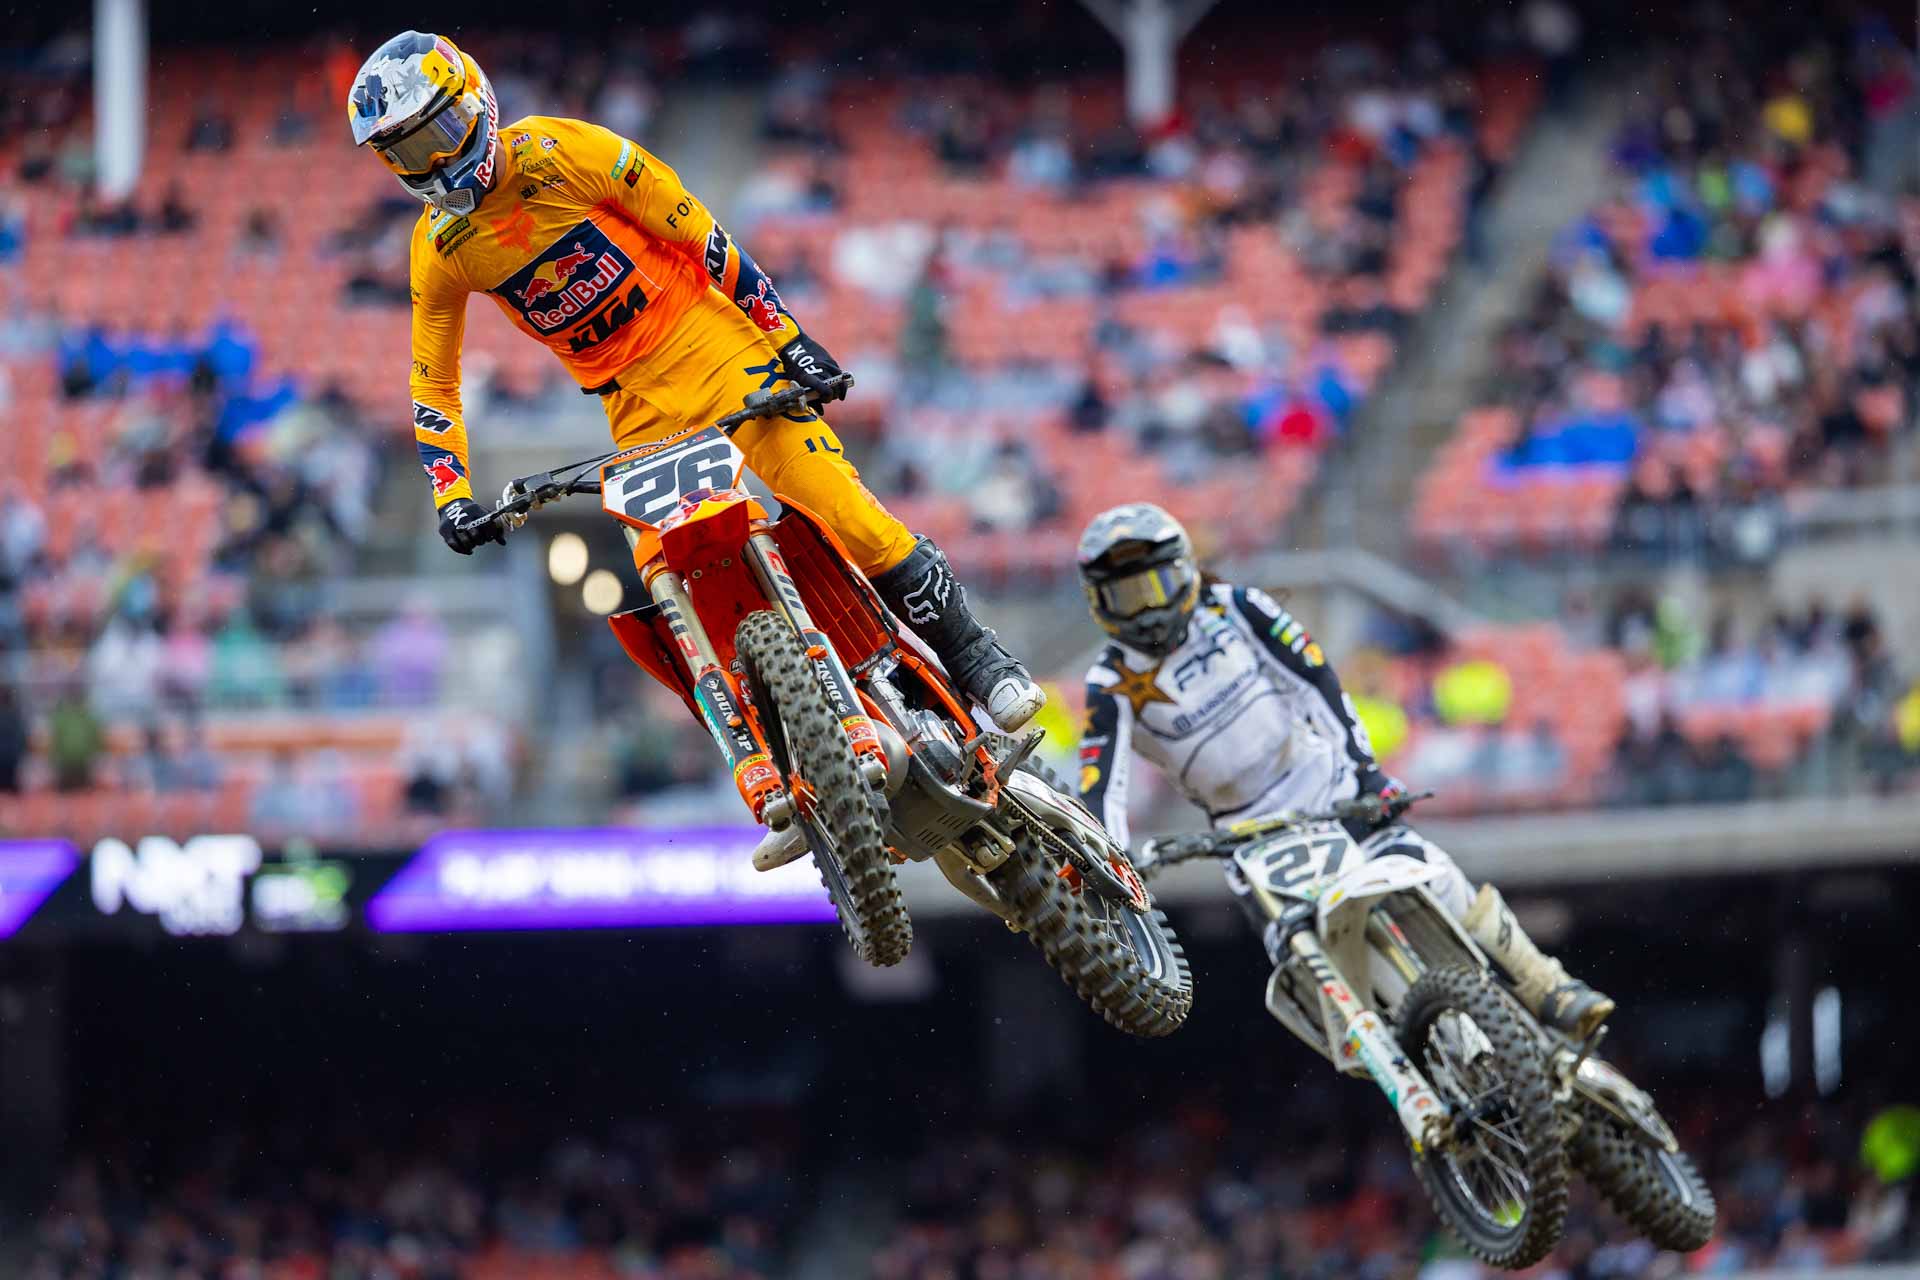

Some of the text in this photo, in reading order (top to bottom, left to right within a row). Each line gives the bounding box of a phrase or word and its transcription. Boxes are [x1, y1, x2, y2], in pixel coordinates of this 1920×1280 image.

[528, 252, 625, 329] Red Bull
[568, 283, 649, 353] KTM
[788, 344, 823, 374] FOX
[414, 402, 453, 433] TM
[623, 443, 733, 526] 26
[816, 660, 844, 701] DUNL
[712, 691, 753, 751] DUNOP
[1265, 838, 1348, 887] 27
